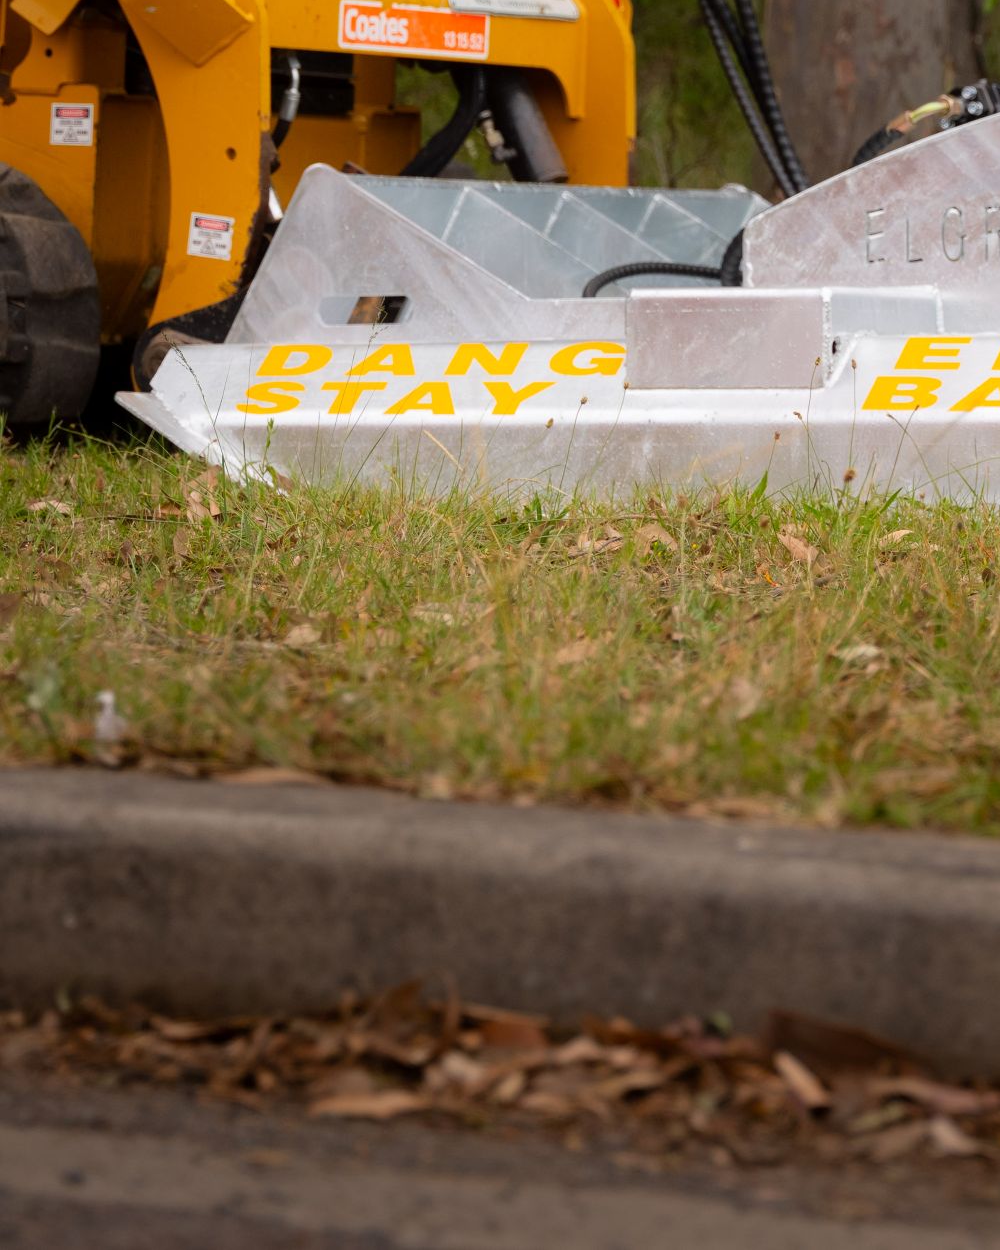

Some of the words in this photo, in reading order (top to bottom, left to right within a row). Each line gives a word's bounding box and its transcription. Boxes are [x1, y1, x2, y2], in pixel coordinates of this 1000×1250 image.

[344, 8, 409, 44] Coates
[255, 341, 627, 377] DANG
[236, 380, 557, 415] STAY
